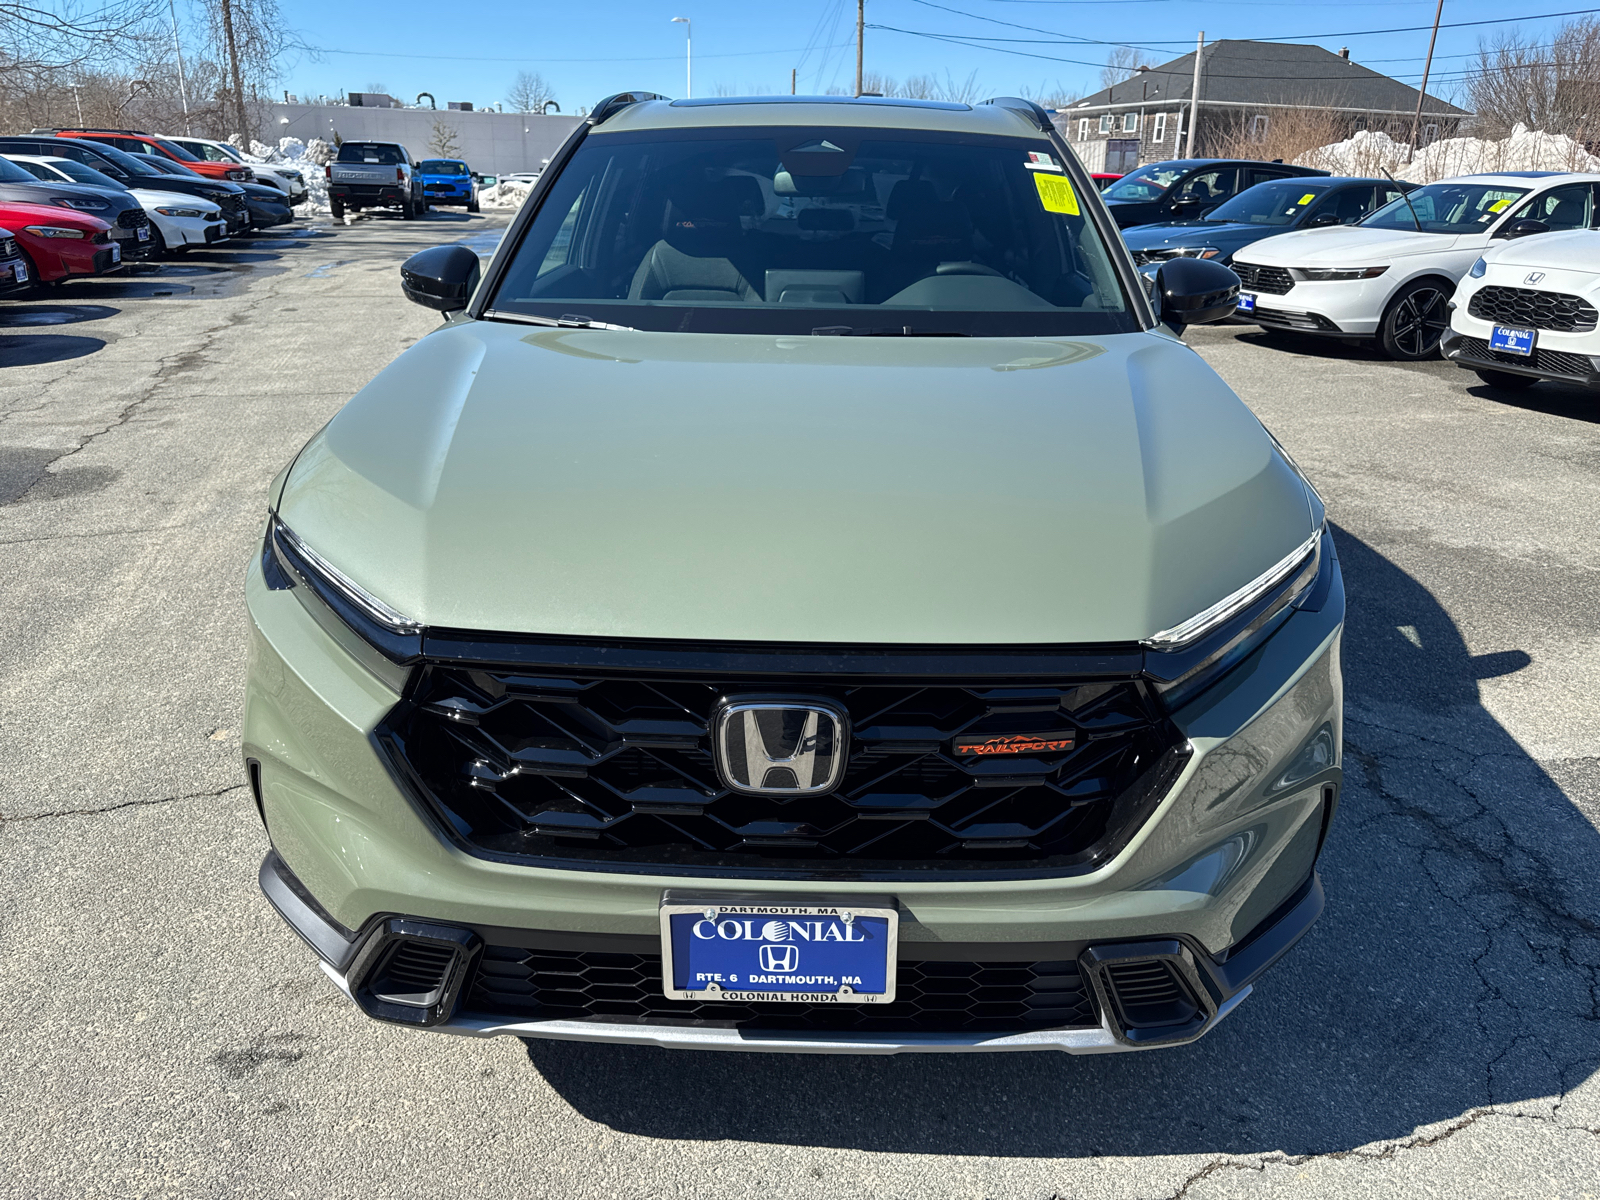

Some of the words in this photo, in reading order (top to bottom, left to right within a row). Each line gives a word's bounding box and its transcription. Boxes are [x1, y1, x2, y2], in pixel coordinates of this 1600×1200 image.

[958, 740, 1073, 755] TRAILSPORT
[719, 906, 813, 915] DARTMOUTH,
[692, 919, 865, 942] COLONIAL
[696, 973, 727, 982] RTE.
[731, 974, 738, 983] 6
[749, 974, 838, 985] DARTMOUTH,
[721, 991, 787, 1001] COLONIAL
[791, 994, 838, 1002] HONDA
